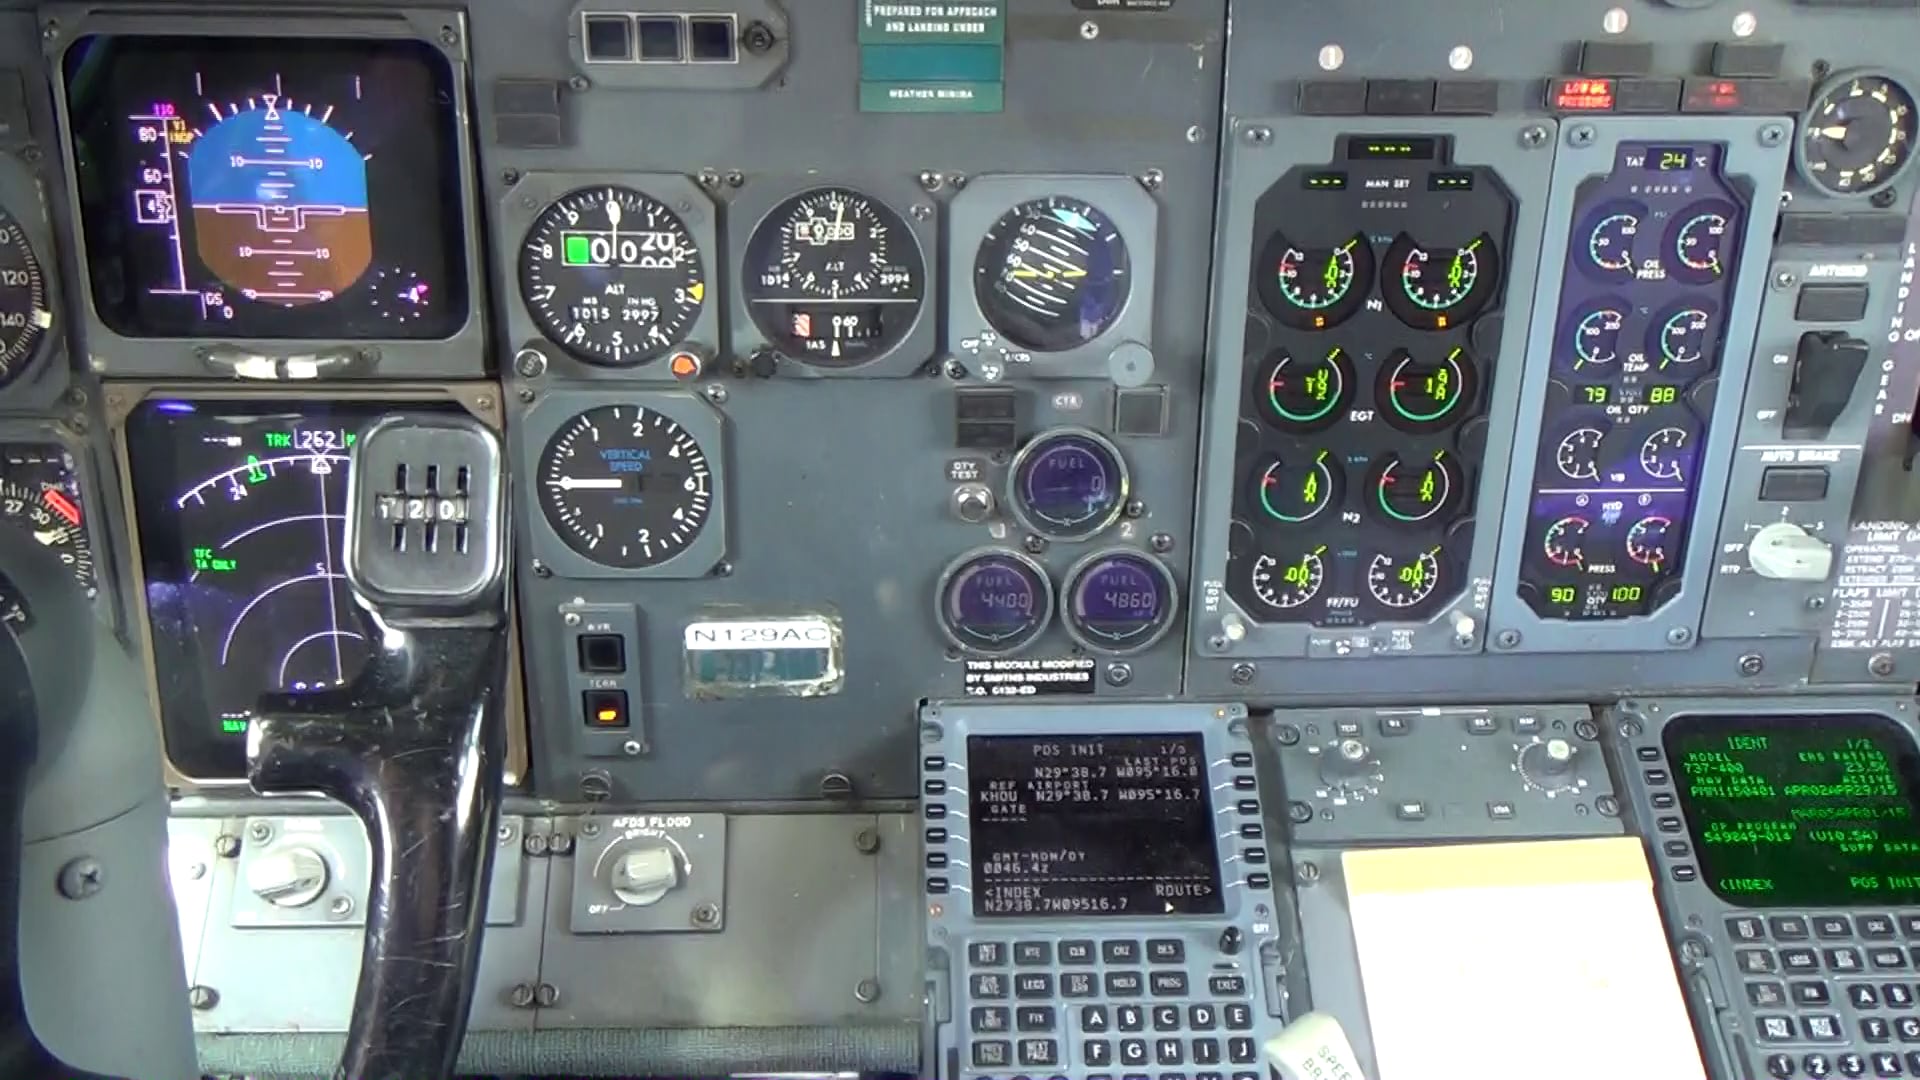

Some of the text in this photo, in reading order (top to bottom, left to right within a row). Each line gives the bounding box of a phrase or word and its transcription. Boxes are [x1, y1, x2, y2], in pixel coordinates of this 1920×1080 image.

[874, 5, 997, 16] PREPARED FOR APPROACH
[885, 22, 985, 33] AND LANDING UNDER
[889, 89, 974, 98] WEATHER MINIMA
[139, 127, 157, 142] 80
[230, 156, 245, 167] 10
[309, 158, 323, 170] 10
[1626, 157, 1644, 167] TAT
[1660, 152, 1687, 170] 24
[143, 168, 162, 184] 60
[1365, 179, 1410, 188] MAN SET
[1020, 223, 1036, 235] 40
[1621, 226, 1636, 235] 100
[1708, 226, 1723, 235] 100
[1013, 237, 1029, 252] 50
[239, 246, 253, 258] 10
[315, 248, 330, 259] 10
[1007, 253, 1022, 267] 60
[1644, 260, 1660, 269] OIL
[825, 261, 845, 271] ALT
[2, 270, 29, 286] 120
[880, 274, 910, 284] 2994
[1637, 269, 1666, 279] PRESS
[761, 274, 790, 286] 1014
[604, 284, 625, 295] ALT
[205, 292, 223, 306] GS
[582, 296, 598, 305] MB
[627, 297, 657, 306] IN HG
[1366, 300, 1382, 311] N1
[573, 306, 611, 320] 1015
[622, 308, 659, 321] 2997
[806, 340, 826, 349] IAS
[1628, 353, 1644, 363] OIL
[1773, 355, 1789, 364] ON
[1624, 362, 1649, 372] TEMP
[1055, 395, 1077, 405] CTR
[1584, 387, 1607, 403] 79
[1650, 387, 1675, 403] 88
[1606, 405, 1649, 414] OIL QTY
[1350, 411, 1375, 422] EGT
[265, 433, 292, 447] TRK
[301, 430, 337, 448] 262
[600, 449, 652, 460] VERTICAL
[1761, 450, 1840, 461] AUTO BRAKE
[609, 461, 643, 472] SPEED
[1050, 458, 1085, 470] FUEL
[951, 469, 978, 479] TEST
[5, 500, 24, 514] 27
[1602, 501, 1623, 511] HYD
[30, 507, 51, 525] 30
[1342, 513, 1361, 523] N2
[1851, 520, 1909, 531] LANDING
[1867, 531, 1901, 542] LIMIT
[1723, 544, 1744, 552] OFF
[1588, 564, 1615, 573] PRESS
[976, 576, 1012, 587] FUEL
[1100, 575, 1137, 586] FUEL
[1552, 588, 1575, 602] 90
[1612, 587, 1641, 601] 100
[1833, 588, 1908, 598] FLAPS LIMIT
[982, 593, 1030, 607] 4400
[1104, 593, 1152, 608] 4860
[1586, 596, 1607, 605] QTY
[695, 627, 827, 643] N129AC
[967, 660, 1094, 670] THIS MODULE MODIFIED
[966, 672, 1089, 683] BY SMITHS INDUSTRIES
[1727, 736, 1768, 750] IDENT
[1033, 743, 1186, 756] POS INIT 1/3
[1124, 756, 1196, 766] LAST POS
[1689, 752, 1731, 762] MODEL
[1683, 762, 1745, 774] 737-400
[990, 780, 1088, 790] REF AIRPORT
[980, 791, 1018, 802] KHOU
[990, 804, 1027, 814] GATE
[612, 816, 691, 828] AFDS FLOOD
[985, 884, 1212, 898] <INDEX ROUTE>
[589, 904, 609, 914] OFF
[1022, 979, 1045, 990] LEGS
[1112, 978, 1137, 988] HOLD
[1029, 1013, 1044, 1023] FIX
[1090, 1011, 1103, 1024] A
[1126, 1010, 1136, 1024] B
[1161, 1010, 1174, 1023] C
[1197, 1009, 1209, 1023] D
[1234, 1008, 1244, 1022] E
[1093, 1045, 1103, 1058] F
[1127, 1044, 1142, 1058] G
[1164, 1044, 1176, 1057] H
[1203, 1044, 1208, 1057] I
[1239, 1042, 1247, 1056] J
